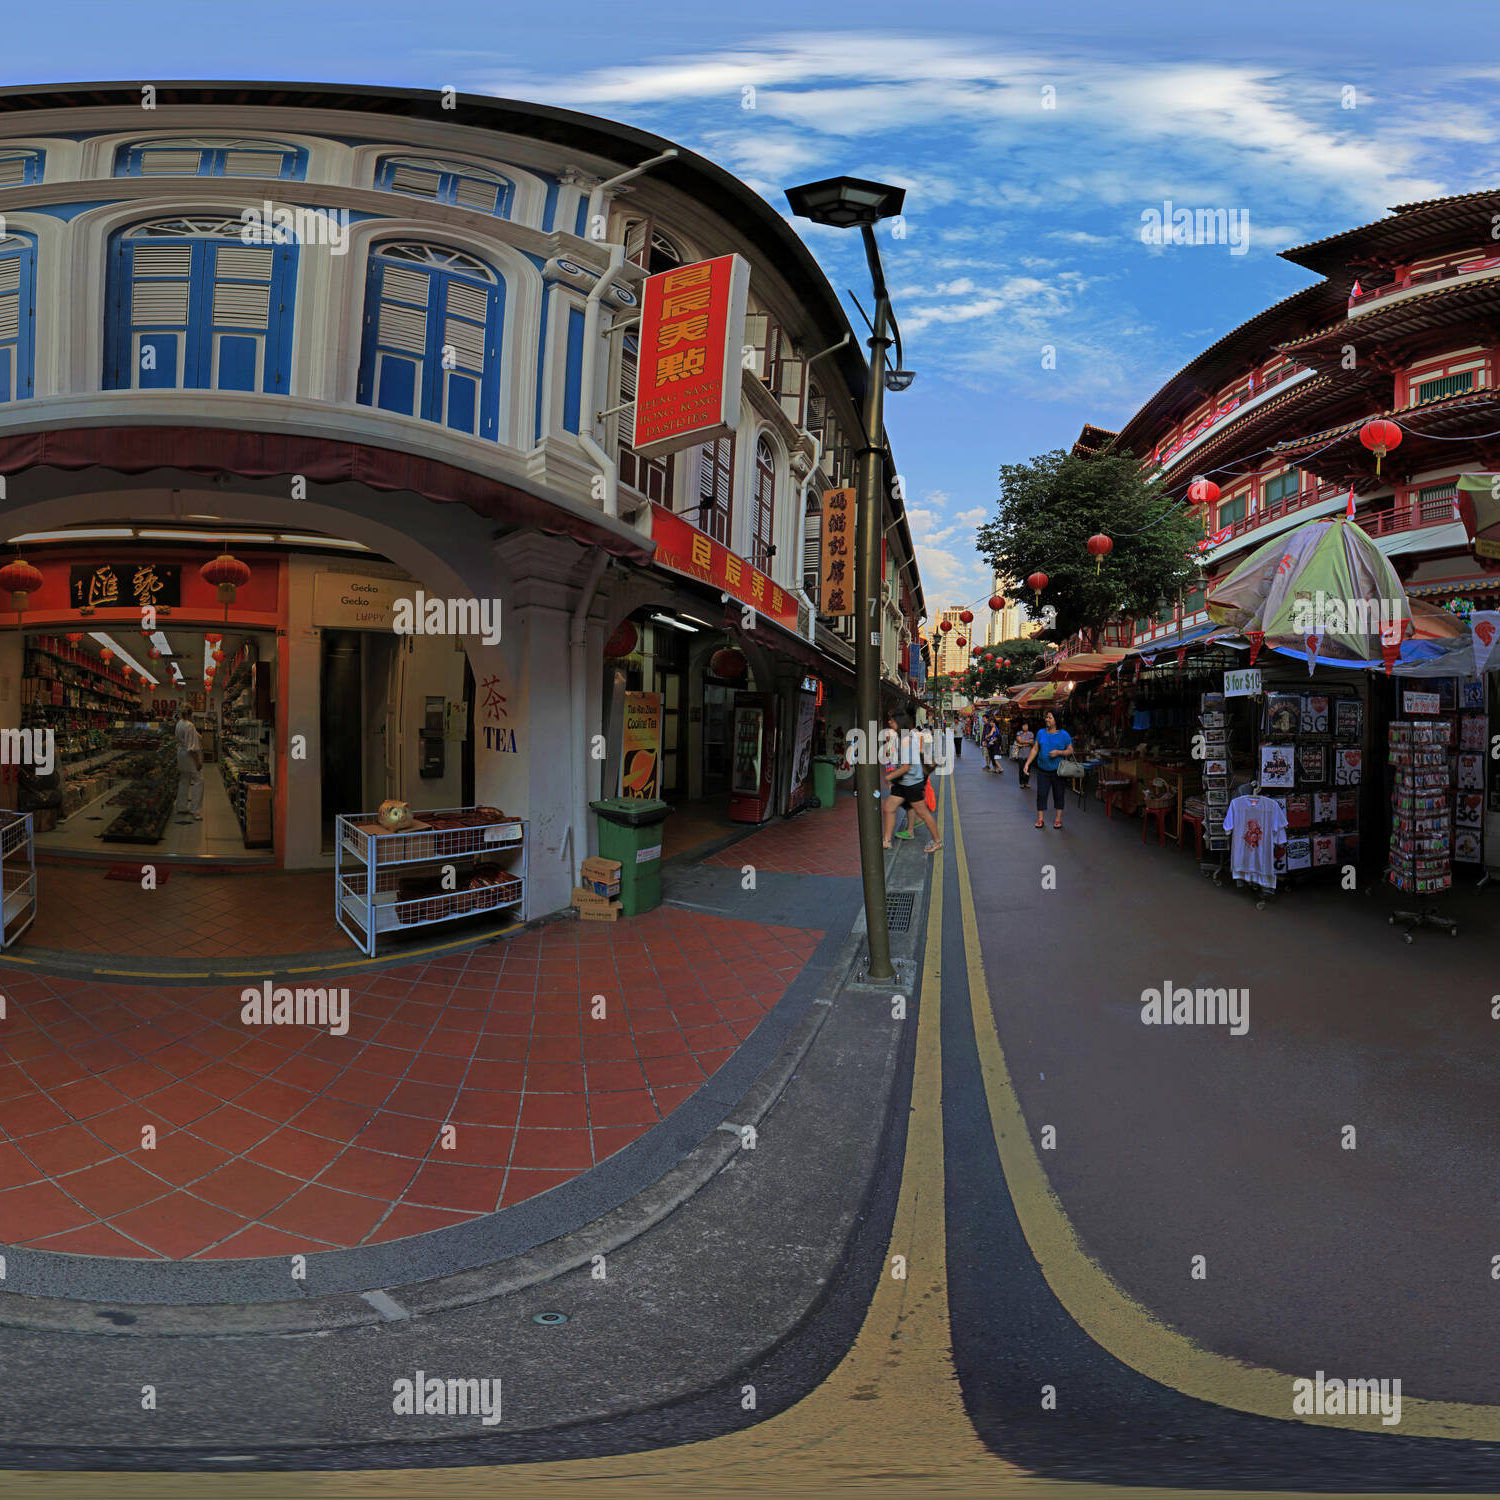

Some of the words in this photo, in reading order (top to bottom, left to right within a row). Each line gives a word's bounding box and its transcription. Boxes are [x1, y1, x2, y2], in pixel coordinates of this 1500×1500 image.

[685, 381, 720, 396] SANG
[641, 406, 674, 425] HONG
[680, 394, 718, 412] KONG
[646, 411, 708, 437] PASTRIES
[351, 583, 379, 593] Gecko
[340, 596, 370, 606] Gecko
[868, 597, 877, 617] 7
[1226, 674, 1230, 691] 3
[1232, 674, 1244, 691] for
[481, 674, 507, 720] 茶
[1302, 715, 1328, 733] SG
[483, 726, 518, 754] TEA
[1337, 769, 1361, 785] SG
